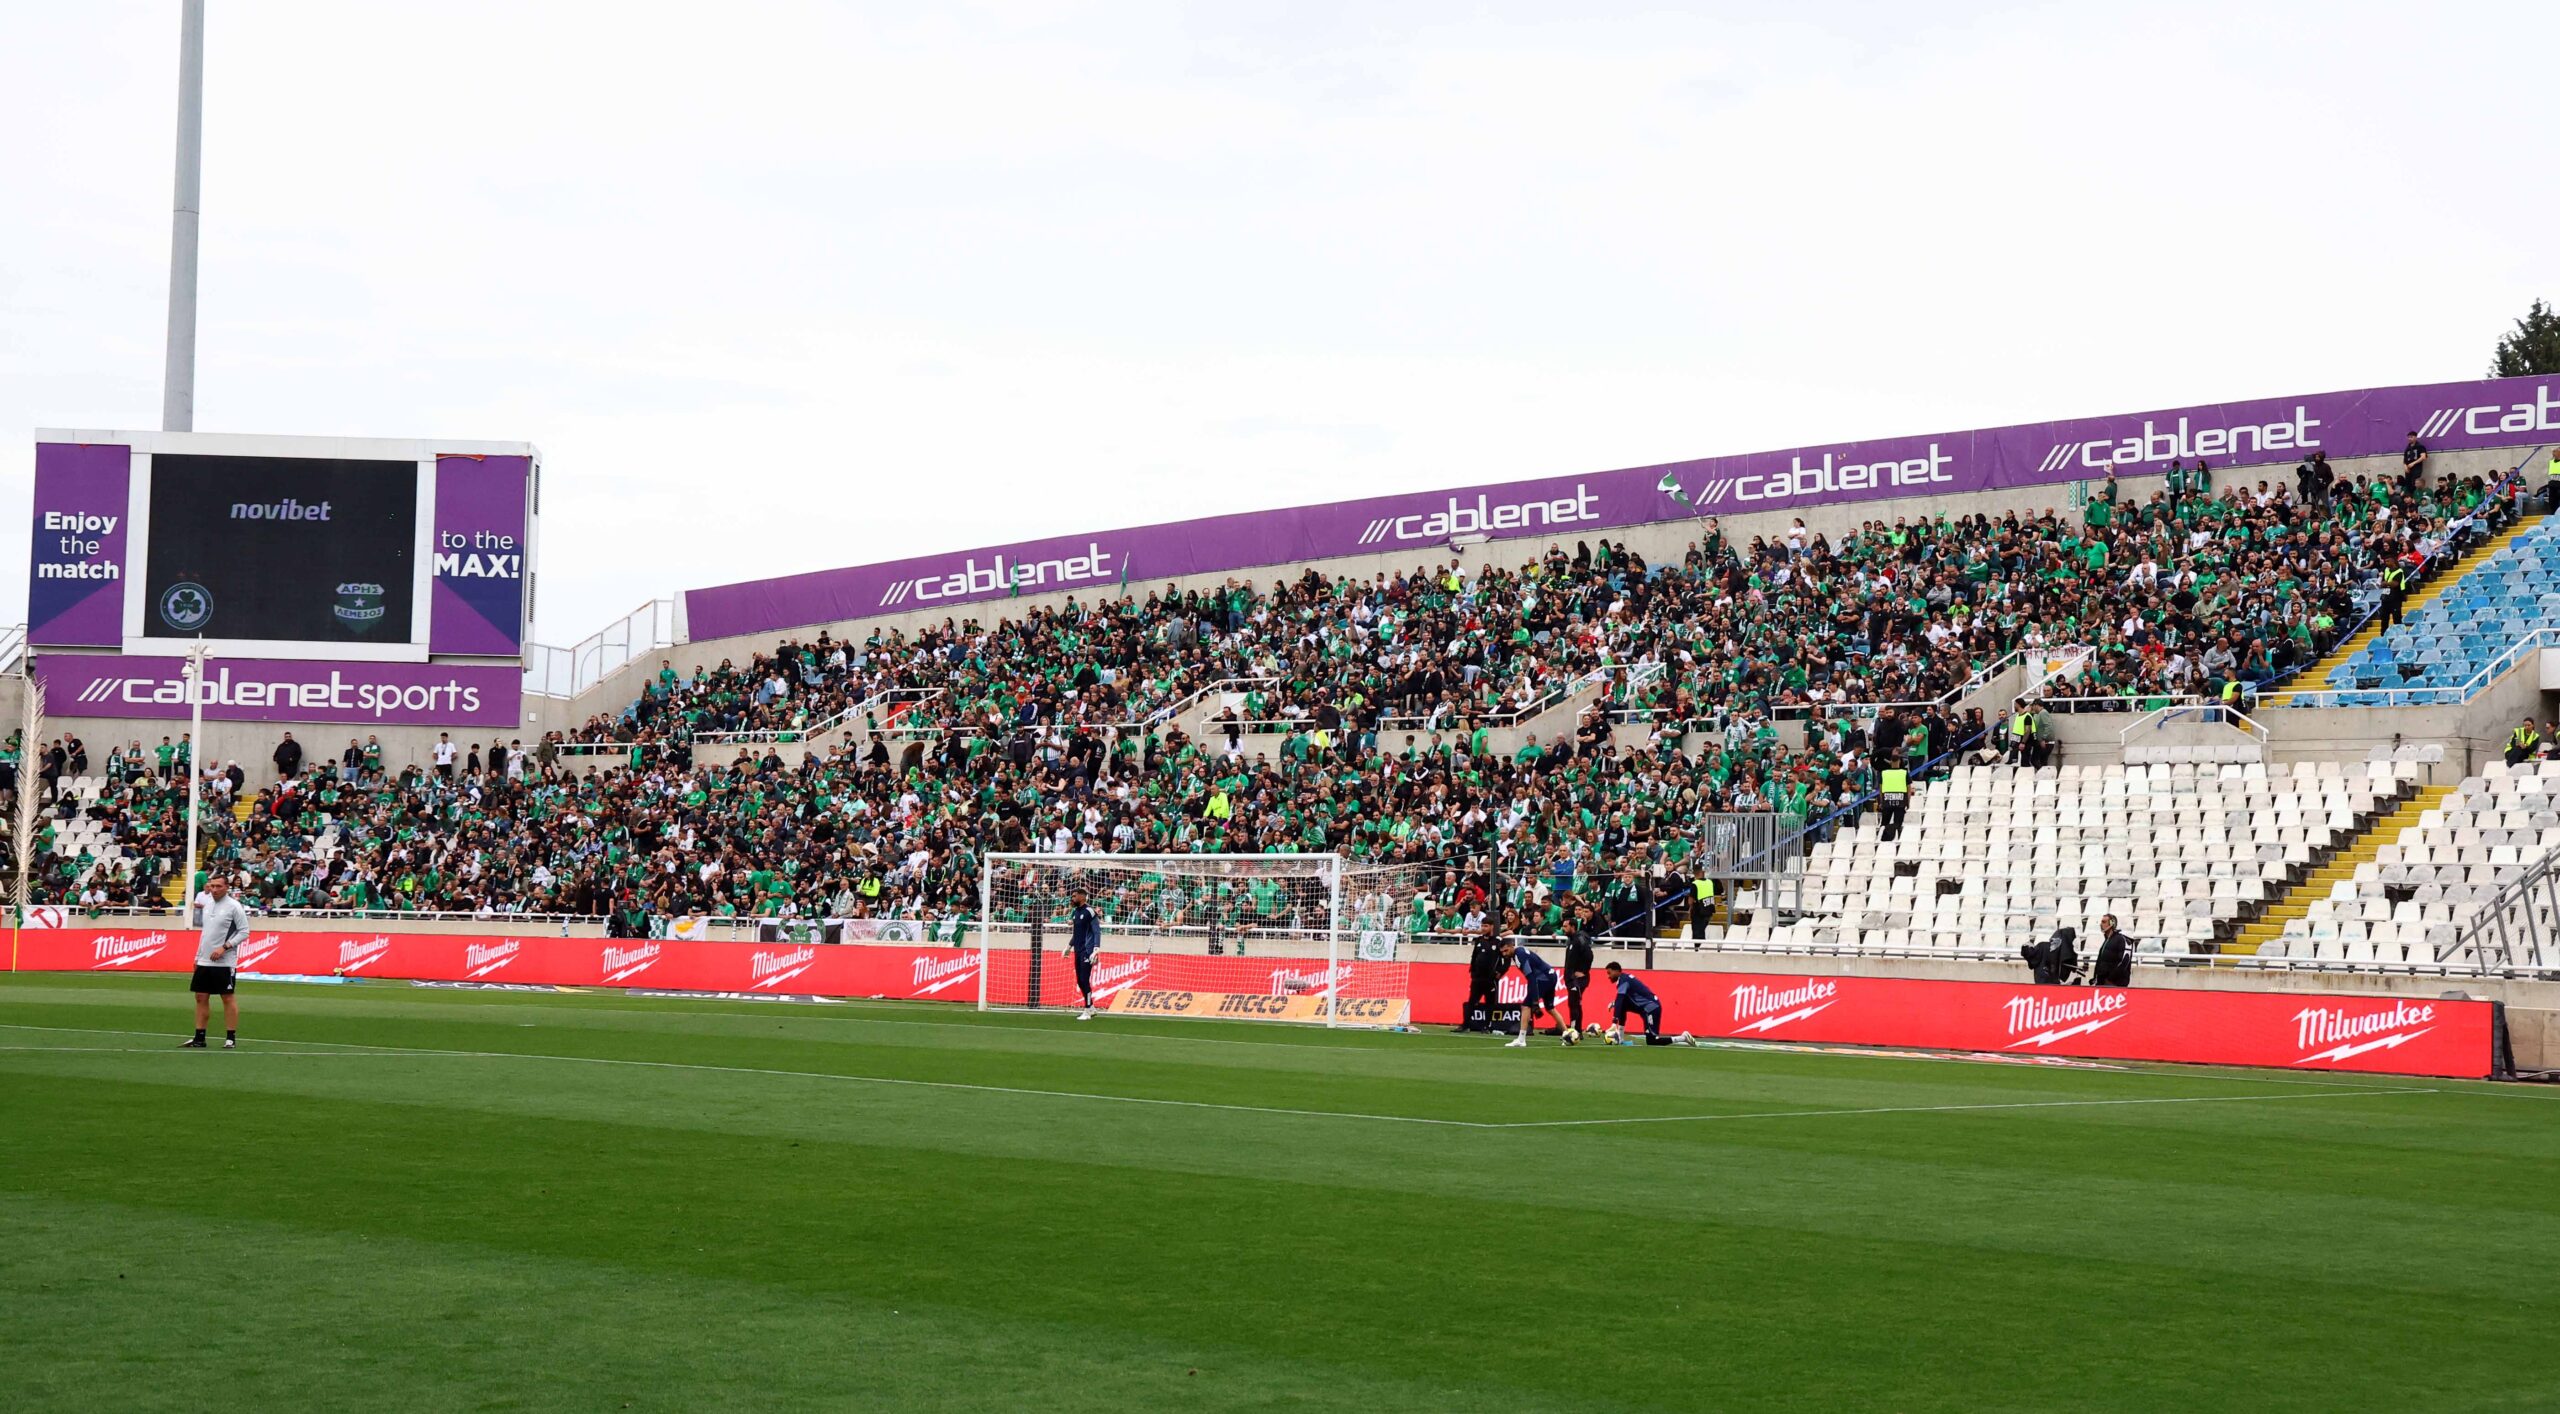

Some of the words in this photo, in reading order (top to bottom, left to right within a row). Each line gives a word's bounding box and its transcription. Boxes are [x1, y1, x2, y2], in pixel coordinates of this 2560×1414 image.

[2081, 406, 2321, 467] cablenet
[1735, 444, 1953, 500] cablenet
[45, 511, 118, 534] Enjoy
[230, 498, 332, 521] novibet
[1396, 484, 1600, 539] cablenet
[60, 536, 100, 555] the
[441, 531, 466, 549] to
[474, 531, 514, 550] the
[38, 561, 119, 580] match
[434, 553, 520, 579] MAX!
[915, 543, 1112, 600] cablenet
[92, 932, 166, 959] Milwaukee
[338, 934, 389, 964] Milwaukee
[465, 938, 520, 969] Milwaukee
[601, 941, 660, 973] Milwaukee
[749, 945, 814, 980] Milwaukee
[1090, 955, 1151, 987] ilwaukee
[1731, 978, 1836, 1021] Milwaukee
[2003, 989, 2126, 1034] Milwaukee
[2291, 1001, 2435, 1049] Milwaukee
